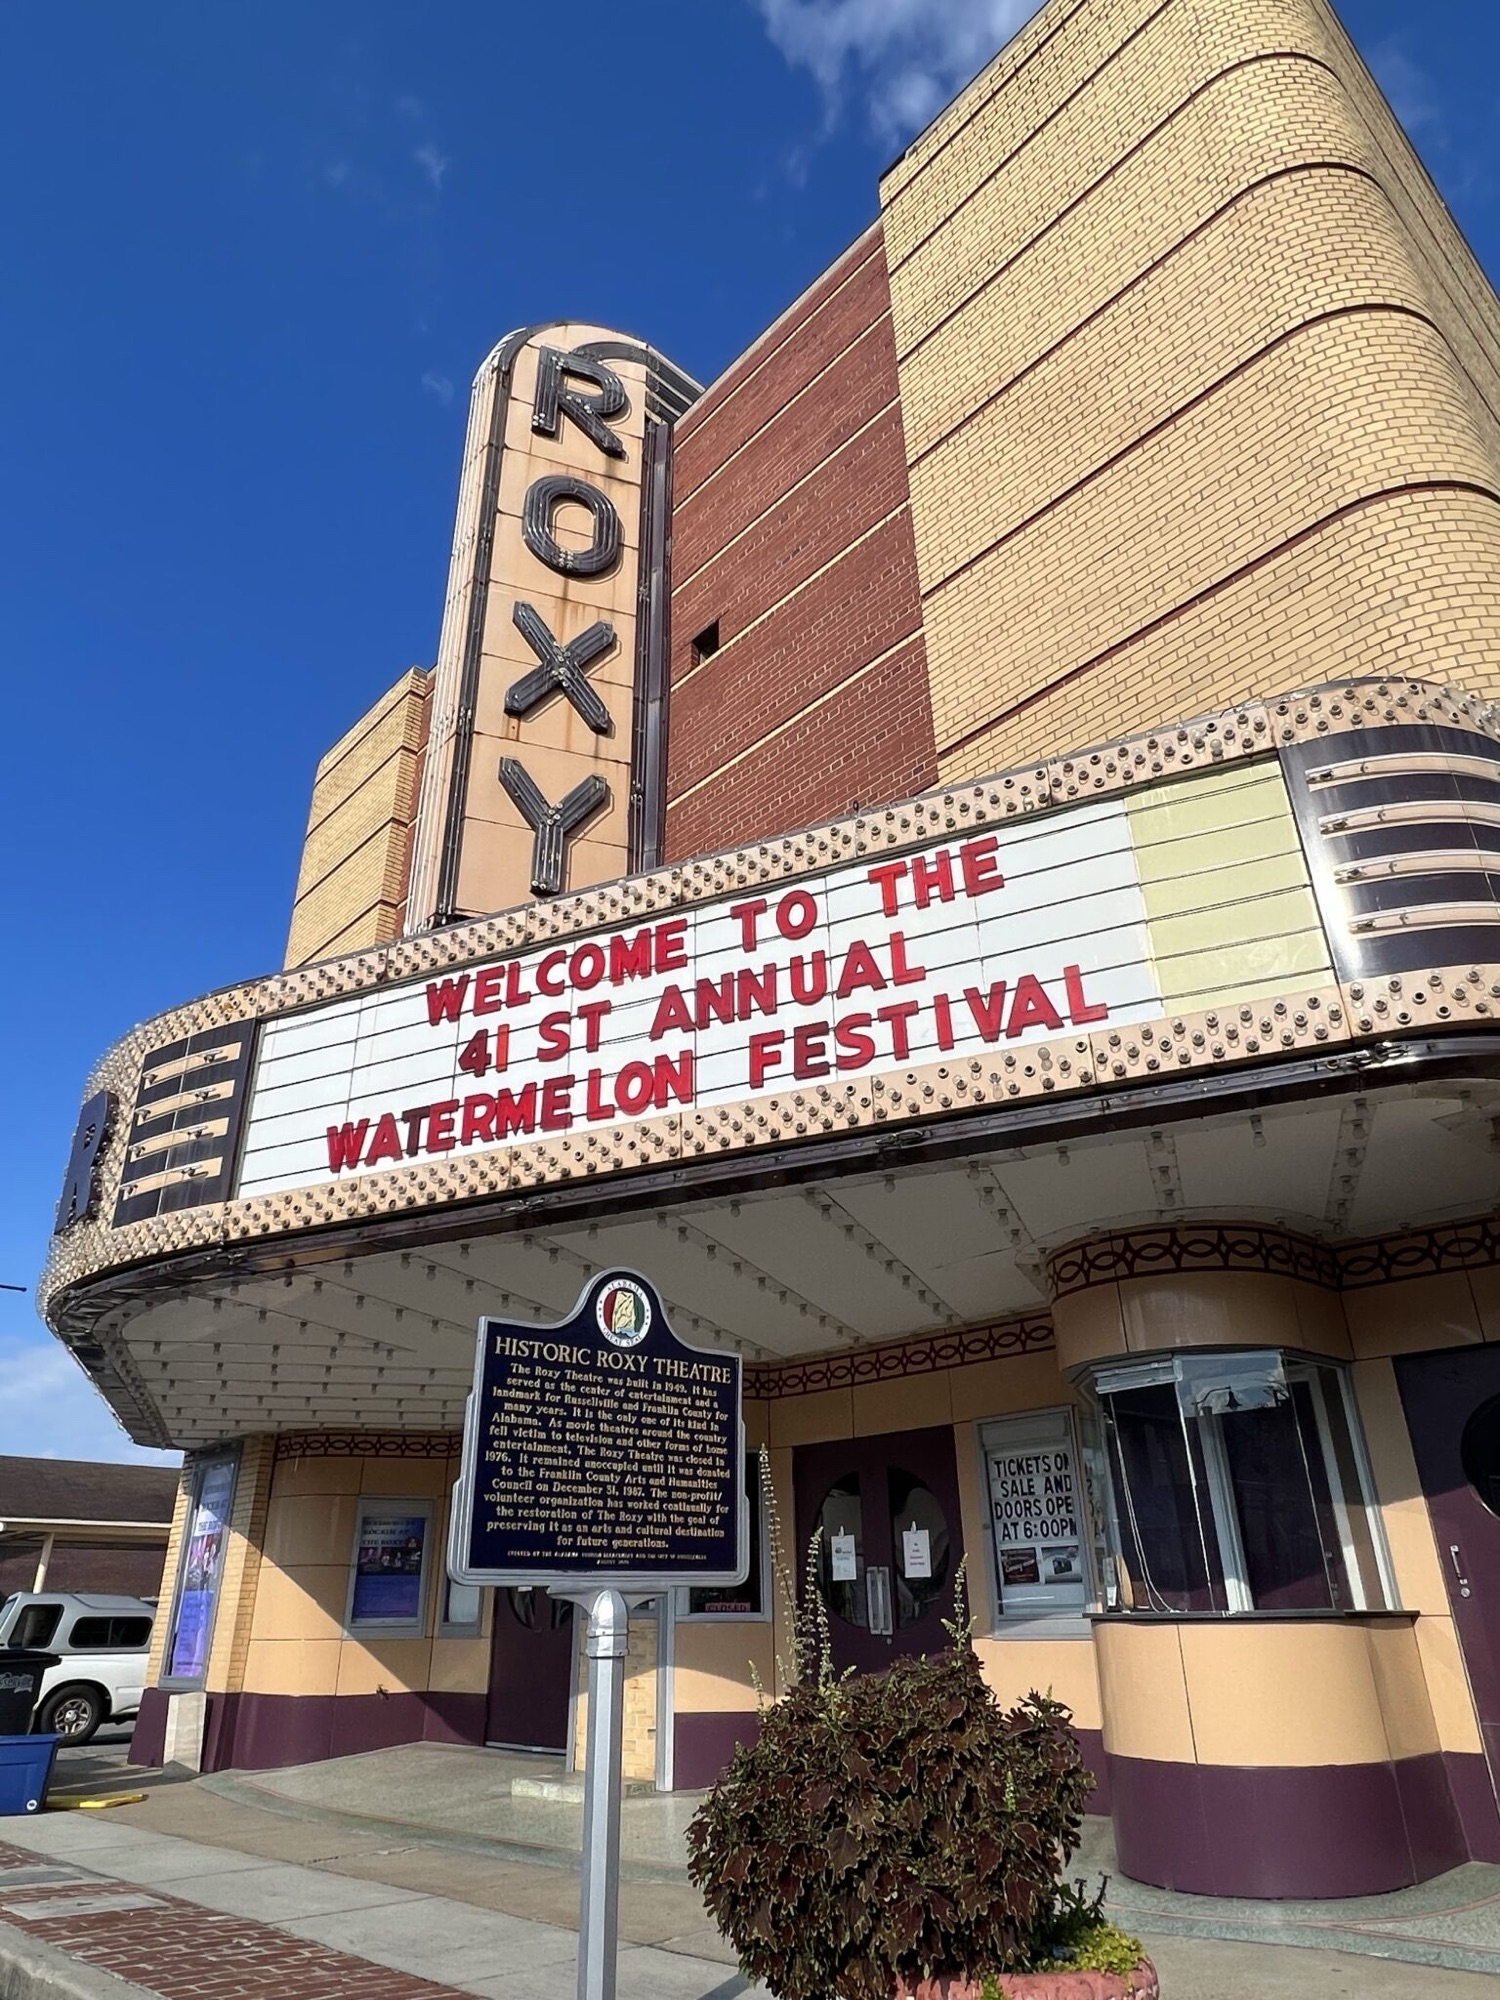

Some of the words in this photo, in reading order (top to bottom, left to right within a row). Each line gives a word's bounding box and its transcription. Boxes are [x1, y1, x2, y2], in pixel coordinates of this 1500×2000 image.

[498, 343, 627, 895] ROXY
[425, 917, 688, 1026] WELCOME
[729, 889, 818, 953] TO
[868, 836, 1004, 917] THE
[649, 930, 926, 1041] ANNUAL
[326, 1049, 694, 1173] WATERMELON
[748, 964, 1109, 1089] FESTIVAL
[494, 1335, 591, 1365] HISTORIC
[596, 1349, 648, 1372] ROXY
[652, 1357, 731, 1384] THEATRE
[506, 1377, 541, 1388] served
[544, 1381, 555, 1390] as
[560, 1381, 576, 1392] the
[579, 1385, 611, 1396] center
[614, 1388, 625, 1398] of
[628, 1391, 691, 1405] entertainment
[694, 1398, 710, 1407] and
[510, 1362, 530, 1374] The
[534, 1365, 561, 1379] Roxy
[564, 1369, 603, 1383] Theatre
[607, 1377, 623, 1386] was
[625, 1376, 649, 1389] built
[652, 1380, 662, 1390] in
[692, 1385, 700, 1395] It
[702, 1386, 717, 1397] has
[492, 1386, 541, 1401] landmark
[544, 1392, 561, 1403] for
[564, 1393, 619, 1409] Russellville
[622, 1401, 639, 1411] and
[642, 1402, 679, 1416] Franklin
[682, 1406, 712, 1420] County
[715, 1410, 728, 1421] for
[503, 1402, 532, 1415] many
[535, 1405, 567, 1416] years.
[572, 1406, 581, 1417] It
[584, 1408, 593, 1418] is
[597, 1409, 613, 1420] the
[616, 1412, 637, 1424] only
[640, 1416, 657, 1425] one
[659, 1417, 670, 1426] of
[673, 1417, 685, 1428] its
[687, 1419, 707, 1430] kind
[710, 1421, 719, 1431] in
[489, 1424, 508, 1436] fell
[512, 1427, 546, 1439] victim
[550, 1430, 562, 1440] to
[565, 1431, 613, 1445] television
[615, 1436, 633, 1446] and
[636, 1438, 661, 1449] other
[664, 1440, 690, 1452] forms
[692, 1443, 703, 1453] of
[705, 1444, 727, 1455] home
[491, 1412, 542, 1426] Alabama.
[548, 1417, 562, 1428] As
[565, 1420, 595, 1431] movie
[599, 1422, 639, 1435] theatres
[641, 1428, 673, 1438] around
[676, 1429, 690, 1440] the
[693, 1433, 727, 1444] country
[519, 1452, 528, 1464] It
[532, 1456, 580, 1468] remained
[584, 1460, 638, 1472] unoccupied
[642, 1463, 664, 1474] until
[667, 1464, 675, 1474] it
[678, 1467, 693, 1476] was
[696, 1466, 730, 1478] donated
[576, 1444, 596, 1456] The
[599, 1446, 624, 1459] Roxy
[627, 1449, 664, 1462] Theatre
[667, 1454, 683, 1463] was
[685, 1454, 713, 1465] closed
[715, 1456, 725, 1466] in
[994, 1455, 1051, 1478] TICKETS
[491, 1478, 532, 1490] Council
[535, 1482, 549, 1492] on
[552, 1481, 603, 1494] December
[650, 1487, 668, 1498] The
[500, 1465, 513, 1476] to
[517, 1466, 535, 1477] the
[538, 1467, 582, 1480] Franklin
[585, 1470, 621, 1484] County
[624, 1474, 646, 1484] Arts
[648, 1475, 666, 1486] and
[668, 1476, 717, 1489] Humanities
[1000, 1478, 1035, 1498] SALE
[1044, 1475, 1072, 1494] AND
[483, 1491, 535, 1504] volunteer
[539, 1495, 603, 1507] organization
[606, 1497, 623, 1508] has
[626, 1499, 660, 1510] worked
[716, 1503, 729, 1513] for
[994, 1499, 1042, 1520] DOORS
[1046, 1496, 1073, 1516] OPE
[486, 1520, 545, 1533] preserving
[548, 1520, 559, 1531] it
[561, 1524, 572, 1532] as
[575, 1524, 588, 1532] an
[591, 1523, 612, 1533] arts
[614, 1524, 632, 1534] and
[635, 1524, 672, 1536] cultural
[674, 1526, 724, 1537] destination
[495, 1505, 514, 1516] the
[517, 1507, 577, 1519] restoration
[581, 1509, 593, 1520] of
[596, 1509, 615, 1520] The
[618, 1511, 643, 1523] Roxy
[646, 1512, 667, 1523] with
[669, 1513, 684, 1523] the
[687, 1515, 706, 1526] goal
[709, 1515, 720, 1525] of
[556, 1535, 573, 1546] for
[576, 1535, 608, 1546] future
[611, 1537, 669, 1549] generations.
[1002, 1521, 1019, 1540] AT
